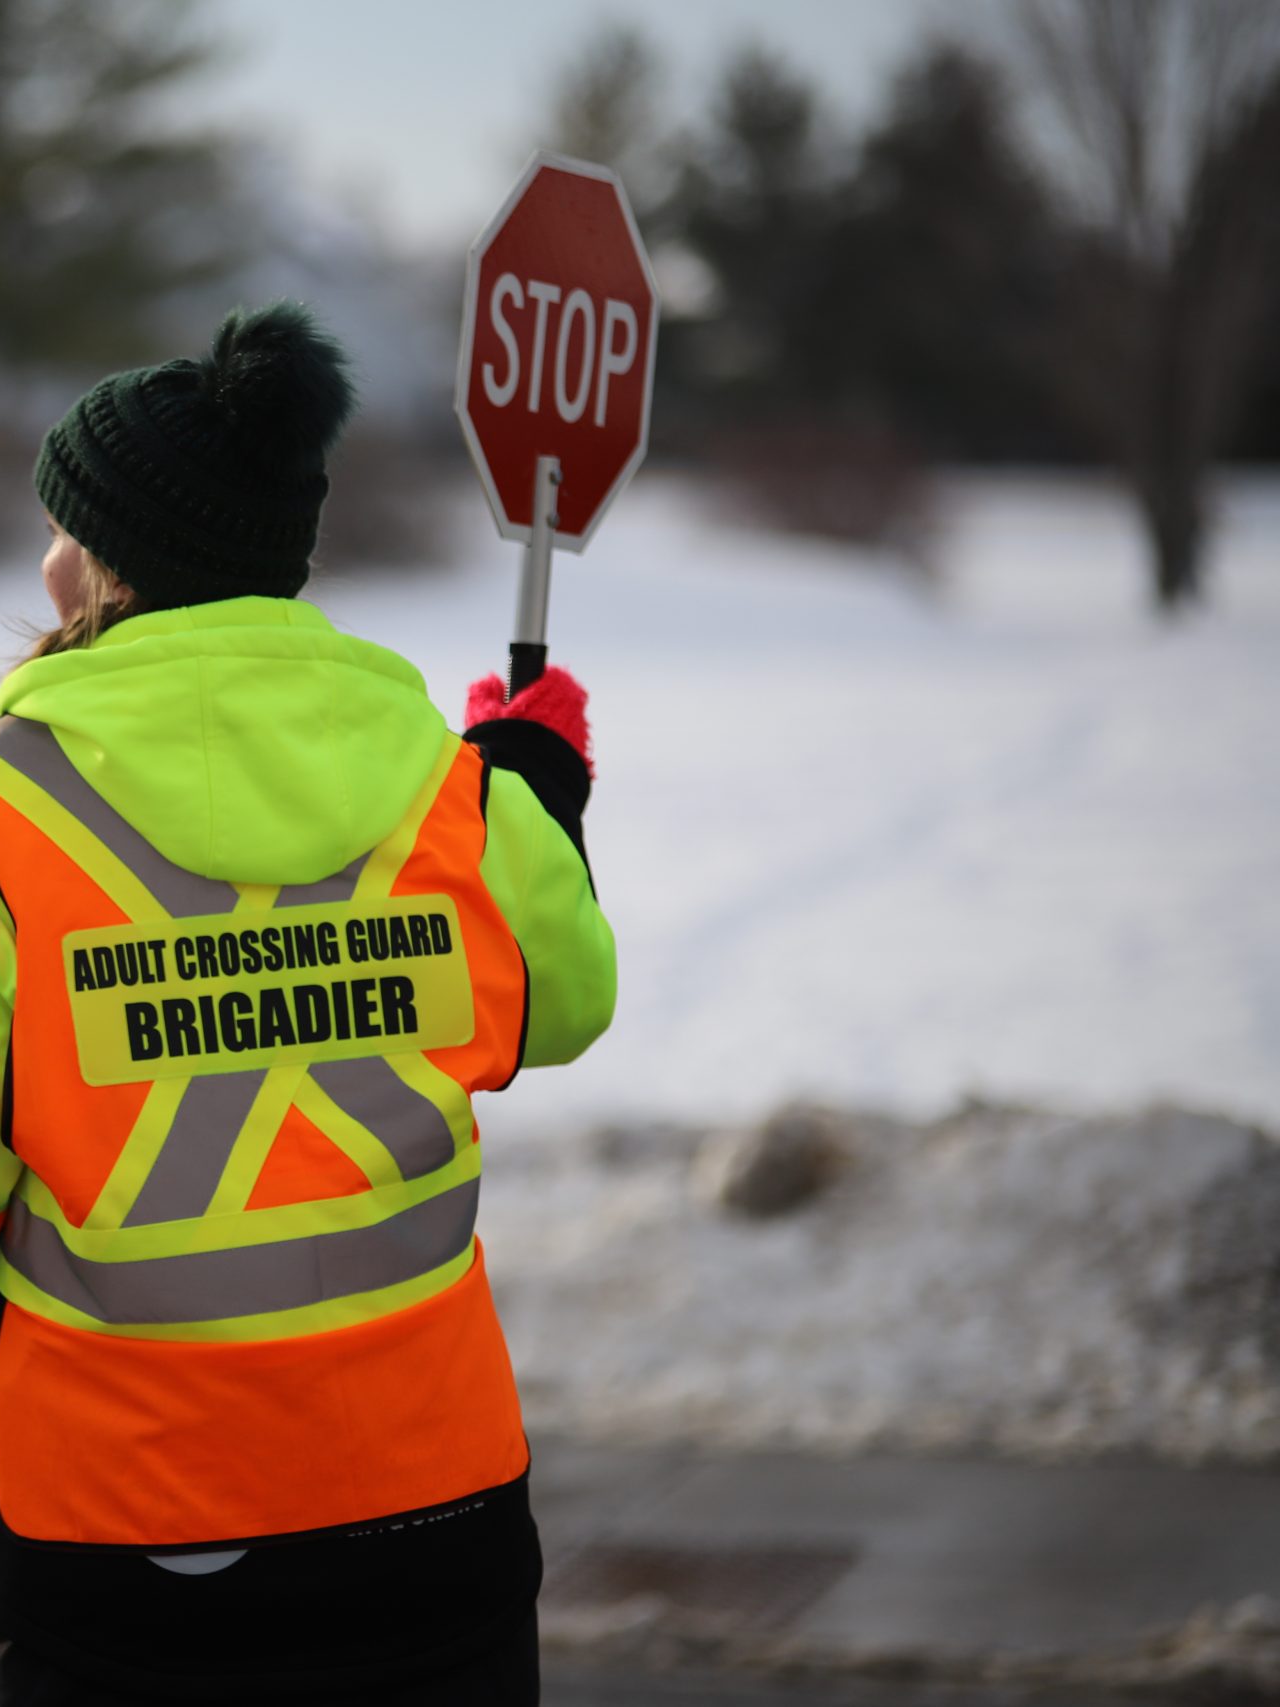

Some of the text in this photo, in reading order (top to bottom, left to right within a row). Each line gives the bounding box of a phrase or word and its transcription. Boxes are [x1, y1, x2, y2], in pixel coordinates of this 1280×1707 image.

[482, 272, 638, 427] STOP
[73, 913, 453, 992] ADULT CROSSING GUARD
[124, 975, 419, 1062] BRIGADIER
